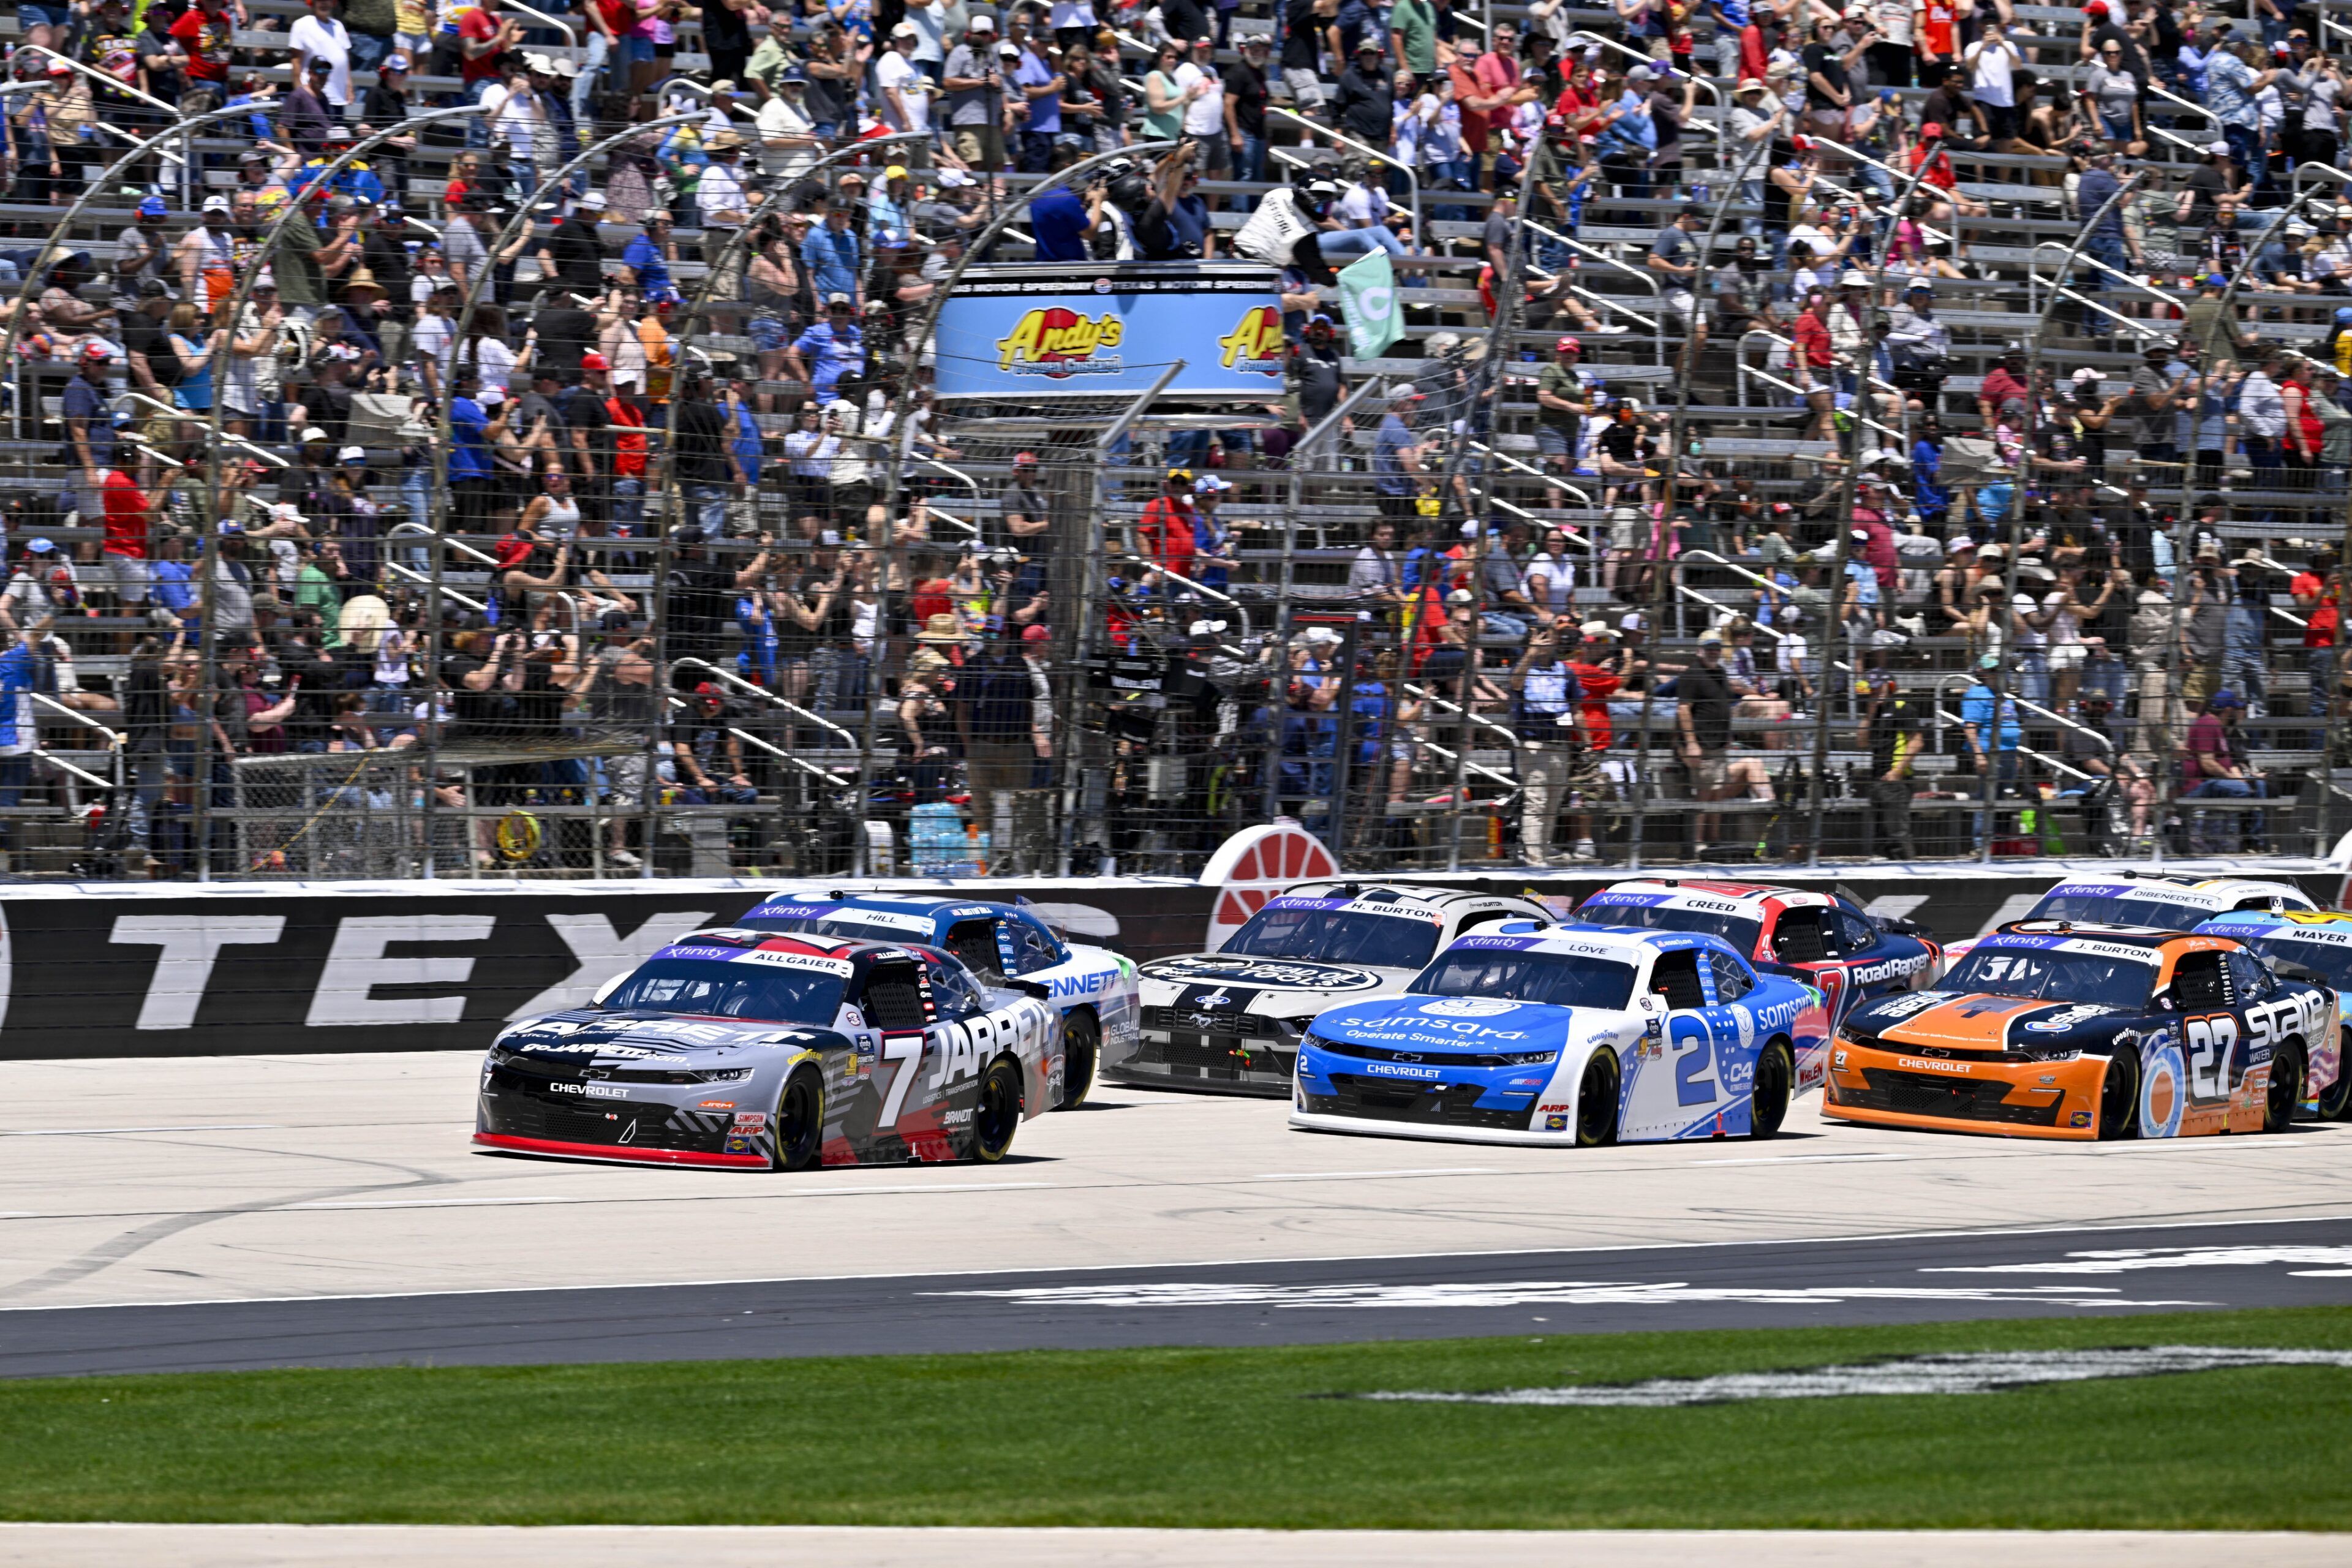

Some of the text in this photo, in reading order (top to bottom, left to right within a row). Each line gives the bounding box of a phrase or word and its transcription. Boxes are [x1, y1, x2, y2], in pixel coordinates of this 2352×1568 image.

[1266, 197, 1292, 236] OFFICIAL
[972, 283, 1021, 292] MOTOR
[1021, 281, 1093, 291] SPEEDWAY
[1114, 281, 1156, 290] TEXAS
[1158, 281, 1213, 289] MOTOR
[997, 309, 1122, 371] Andy's
[2060, 884, 2114, 895] xfinity
[1276, 898, 1333, 910] xfinity
[1599, 894, 1654, 905] xfinity
[1686, 899, 1737, 912] CREED
[759, 905, 818, 916] xfinity
[1372, 905, 1436, 919] BURTON
[865, 914, 897, 924] HILL
[2205, 924, 2260, 936] xfinity
[2293, 930, 2348, 943] MAYER
[1463, 937, 1523, 949] xfinity
[1992, 934, 2049, 948] xfinity
[666, 946, 729, 959] xfinity
[1569, 944, 1608, 955] LOVE
[2092, 944, 2152, 959] BURTON
[754, 953, 837, 970] ALLGAIER
[1252, 963, 1318, 979] DEAD
[1038, 968, 1119, 998] ENNETT
[1758, 993, 1812, 1030] samsara
[2245, 989, 2324, 1049] state
[497, 1019, 816, 1042] JARRETT
[562, 1030, 651, 1038] TRANSPORTATION
[1110, 1020, 1139, 1036] GLOBAL
[1340, 1017, 1525, 1041] samsara
[1346, 1030, 1406, 1041] Operate
[929, 996, 1055, 1090] JARRETT
[1110, 1033, 1139, 1045] INDUSTRIAL
[1587, 1029, 1619, 1044] GOODYEAR
[2113, 1027, 2141, 1046] GOODYEAR
[521, 1042, 687, 1063] goJARRETT.com
[786, 1048, 823, 1066] GOODYEAR
[1834, 1051, 1846, 1066] 27
[2187, 1017, 2237, 1099] 27
[2249, 1049, 2271, 1064] WATER
[1300, 1055, 1308, 1071] 2
[1669, 1015, 1717, 1107] 2
[1898, 1058, 1972, 1072] CHEVROLET
[1366, 1065, 1441, 1079] CHEVROLET
[1730, 1061, 1753, 1082] C4
[1799, 1058, 1823, 1086] WHELEN
[481, 1072, 494, 1090] 7
[877, 1036, 924, 1128] 7
[549, 1082, 630, 1098] CHEVROLET
[922, 1079, 979, 1104] LOGISTICS TRANSPORTATION
[737, 1114, 764, 1123] SIMPSON
[943, 1108, 974, 1125] BRANDT
